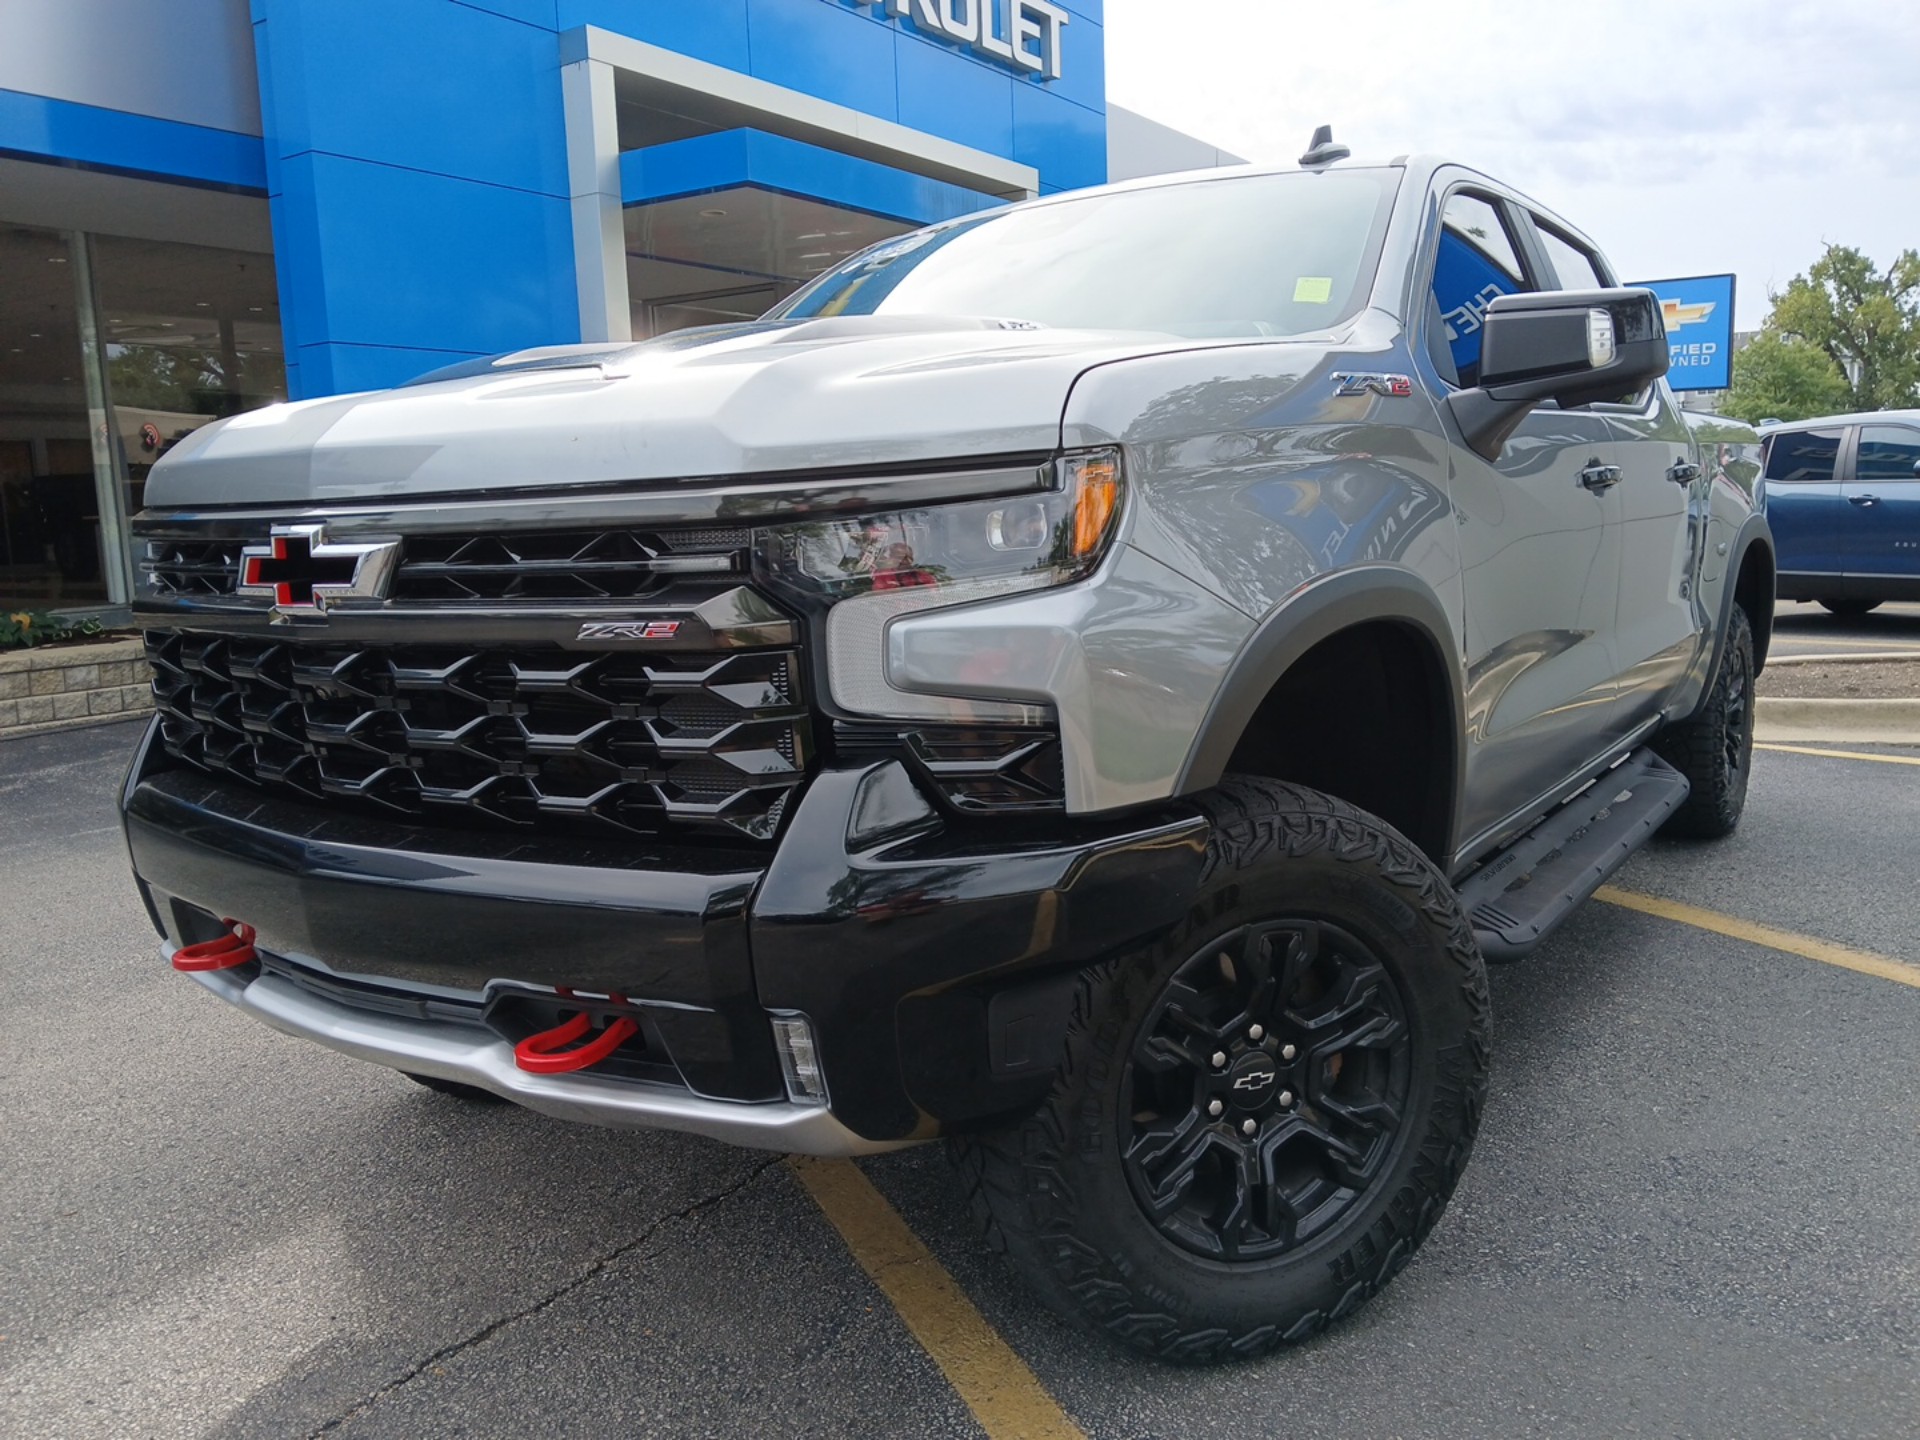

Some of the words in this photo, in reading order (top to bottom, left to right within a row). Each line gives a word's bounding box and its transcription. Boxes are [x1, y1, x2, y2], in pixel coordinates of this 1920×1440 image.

[1670, 342, 1717, 356] FIED
[1329, 371, 1412, 397] ZR2
[574, 620, 682, 641] ZR2
[1326, 1042, 1464, 1288] WRANGLER
